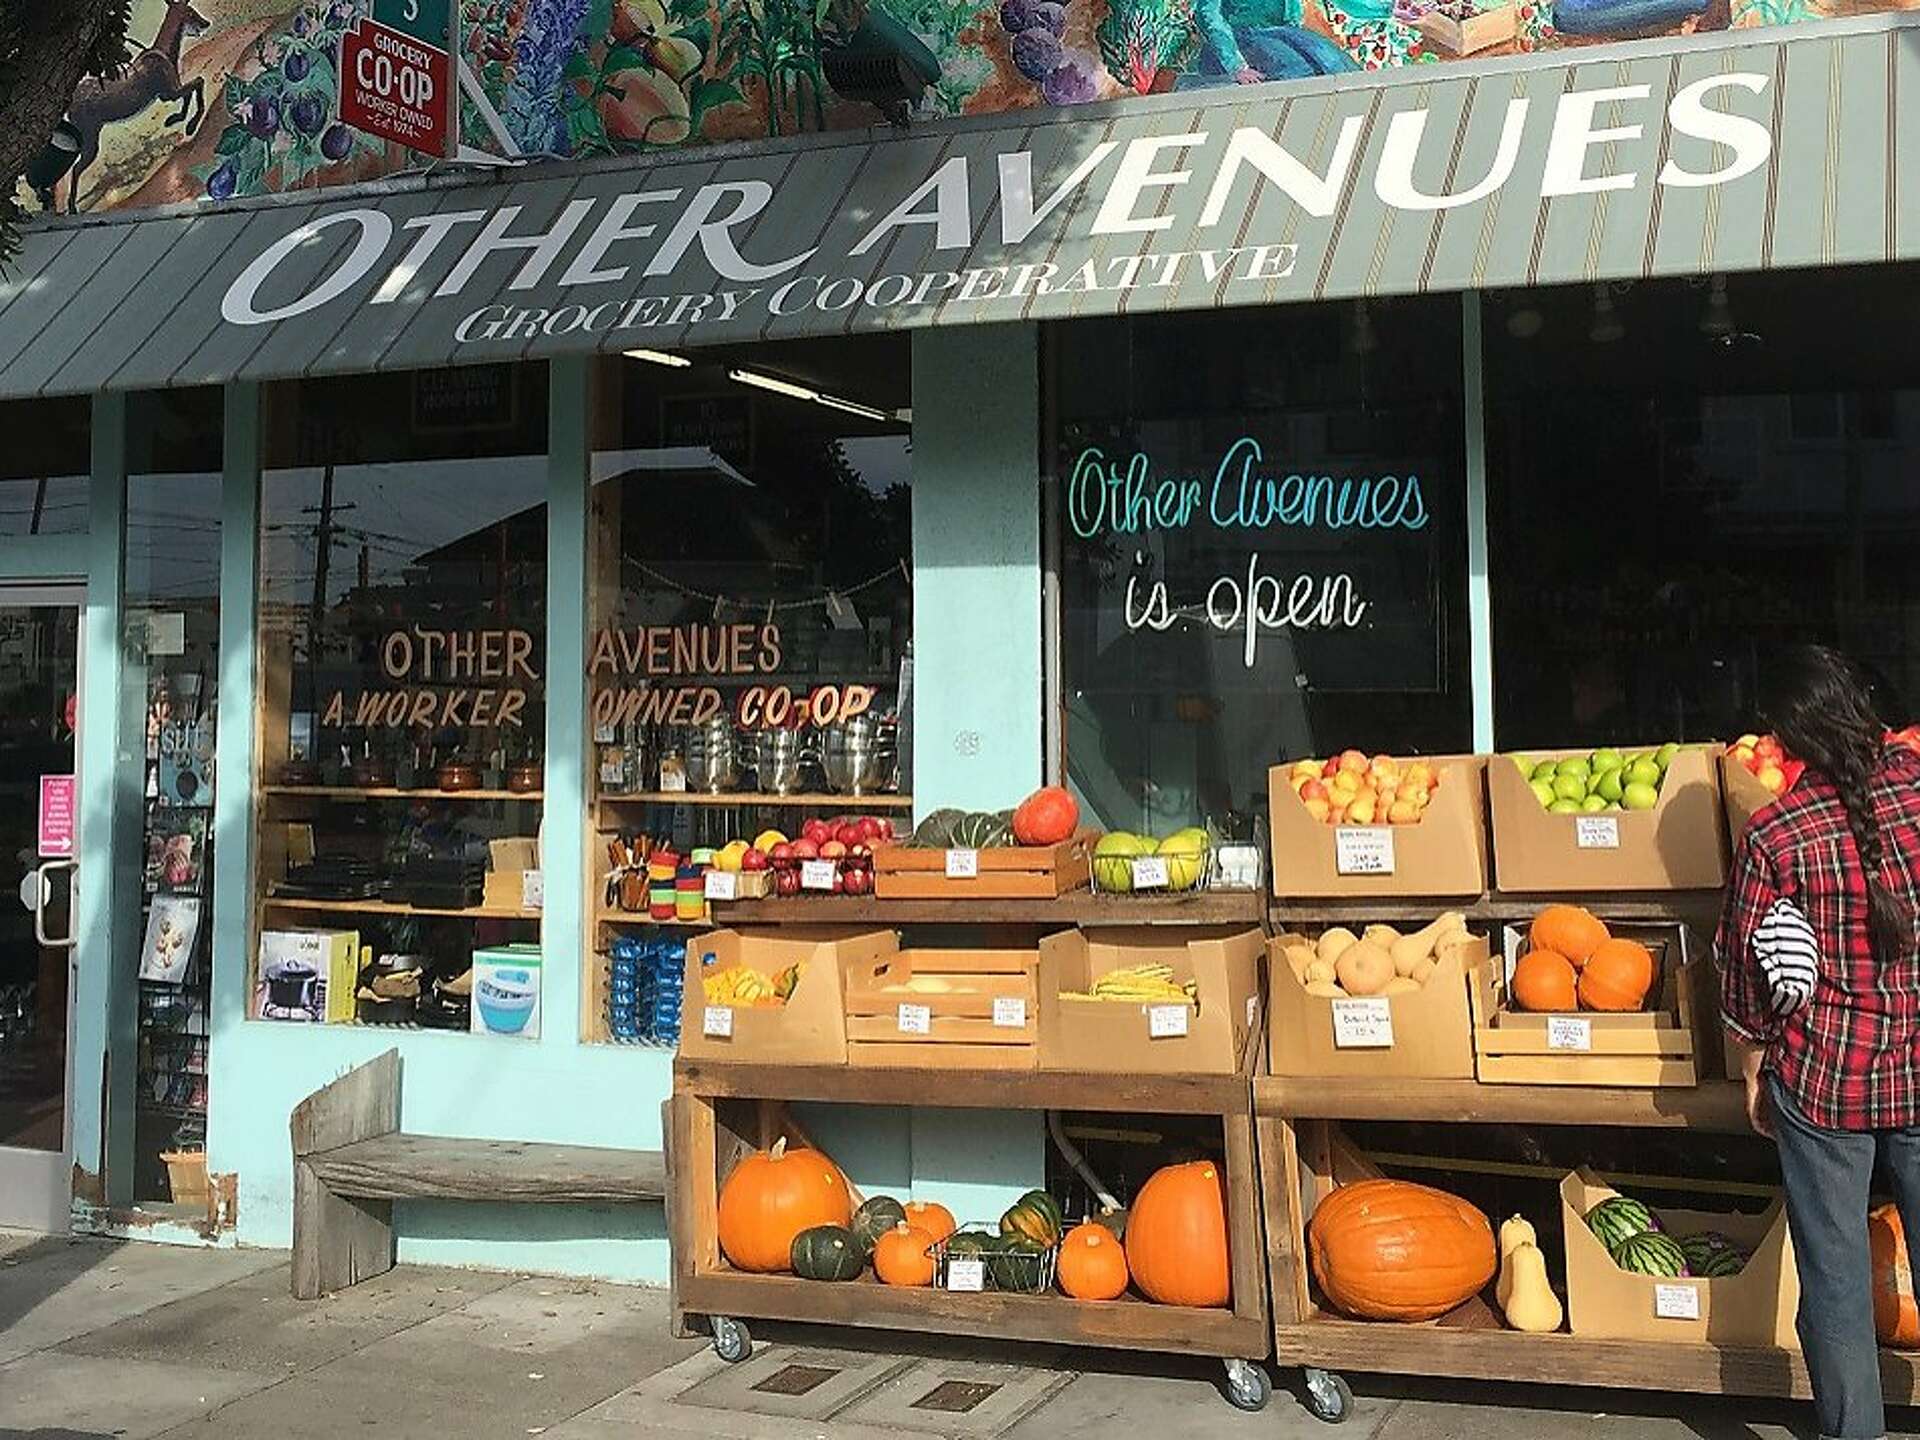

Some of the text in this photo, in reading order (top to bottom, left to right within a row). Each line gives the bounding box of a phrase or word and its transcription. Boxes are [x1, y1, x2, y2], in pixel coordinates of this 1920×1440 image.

[374, 32, 433, 70] GROCERY
[355, 89, 433, 130] WORKER OWNED
[221, 73, 1772, 326] OTHER AVENUES
[454, 244, 1298, 344] GROCERY COOPERATIVE
[1068, 437, 1430, 538] Other Avenues
[1124, 549, 1368, 668] is open
[383, 621, 783, 681] OTHER AVENUES
[321, 690, 344, 729] A
[354, 690, 527, 730] WORKER
[593, 687, 723, 728] OWNED
